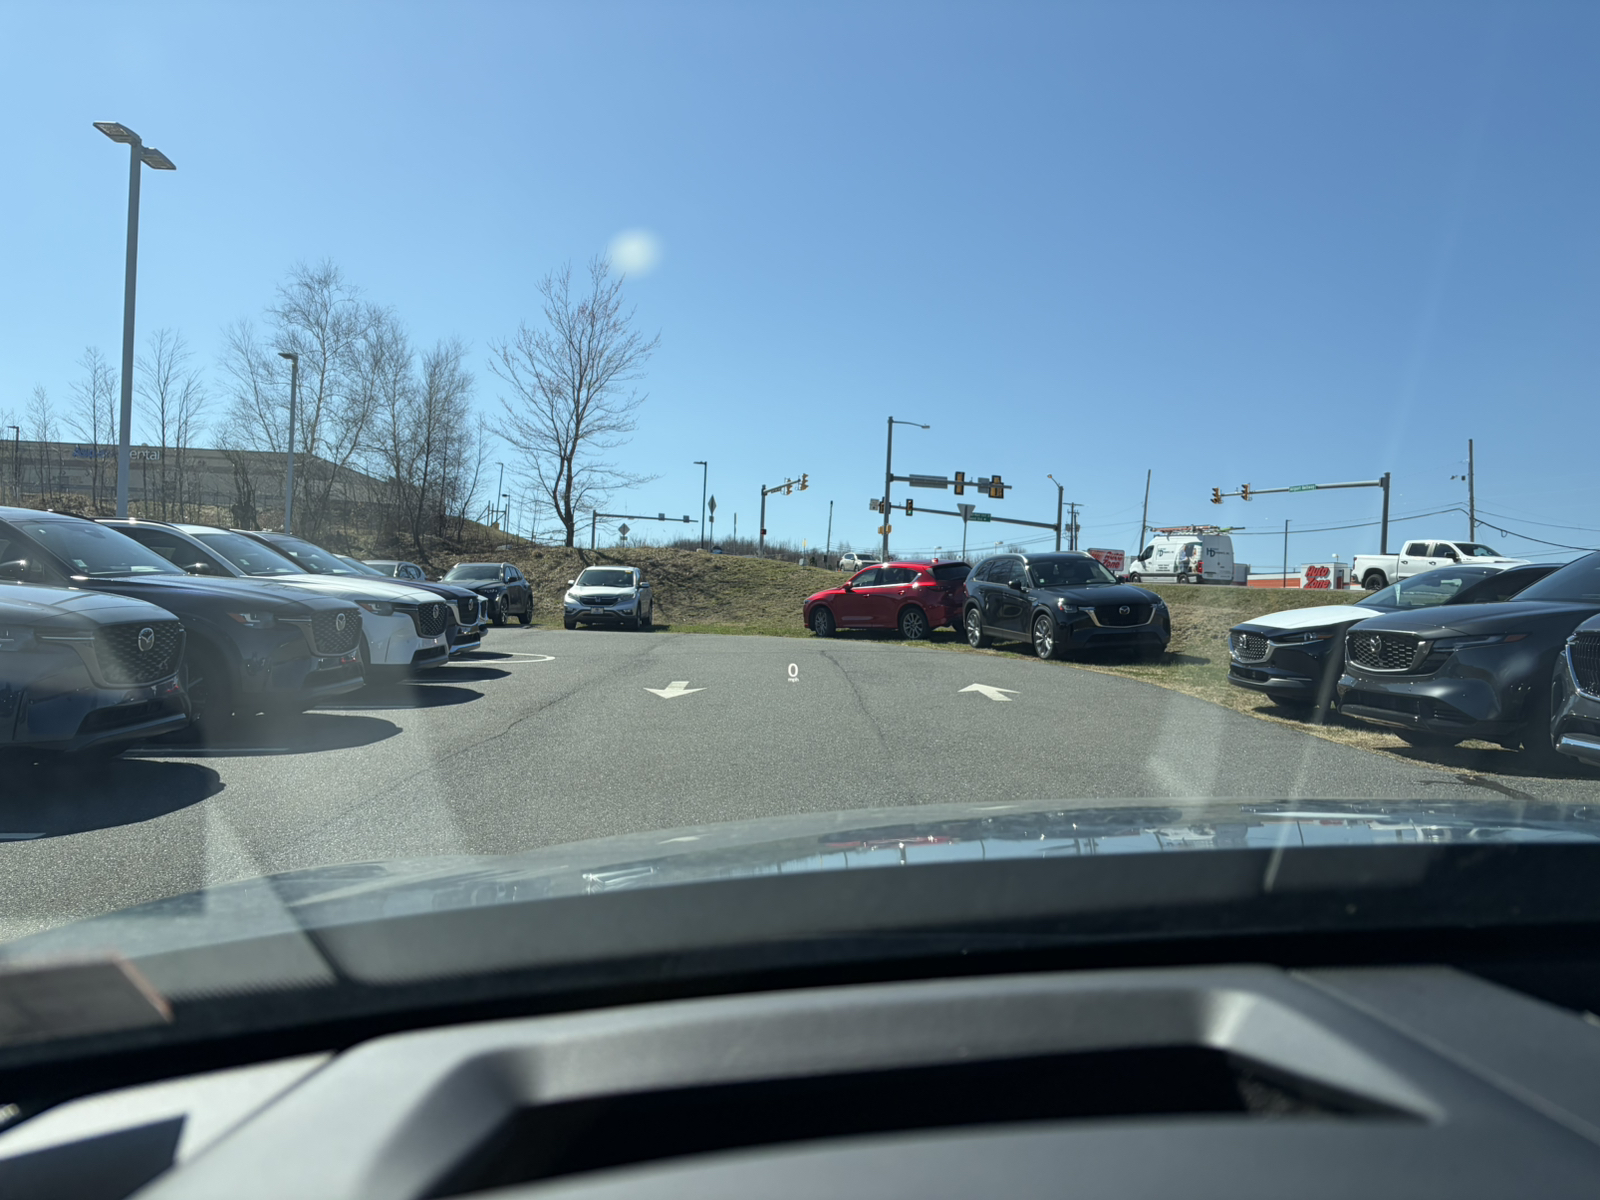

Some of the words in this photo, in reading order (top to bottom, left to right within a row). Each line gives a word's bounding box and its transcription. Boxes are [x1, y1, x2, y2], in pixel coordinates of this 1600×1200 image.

[129, 450, 160, 460] ental
[1305, 565, 1330, 578] Auto
[1303, 577, 1331, 589] Zone
[787, 663, 799, 677] 0
